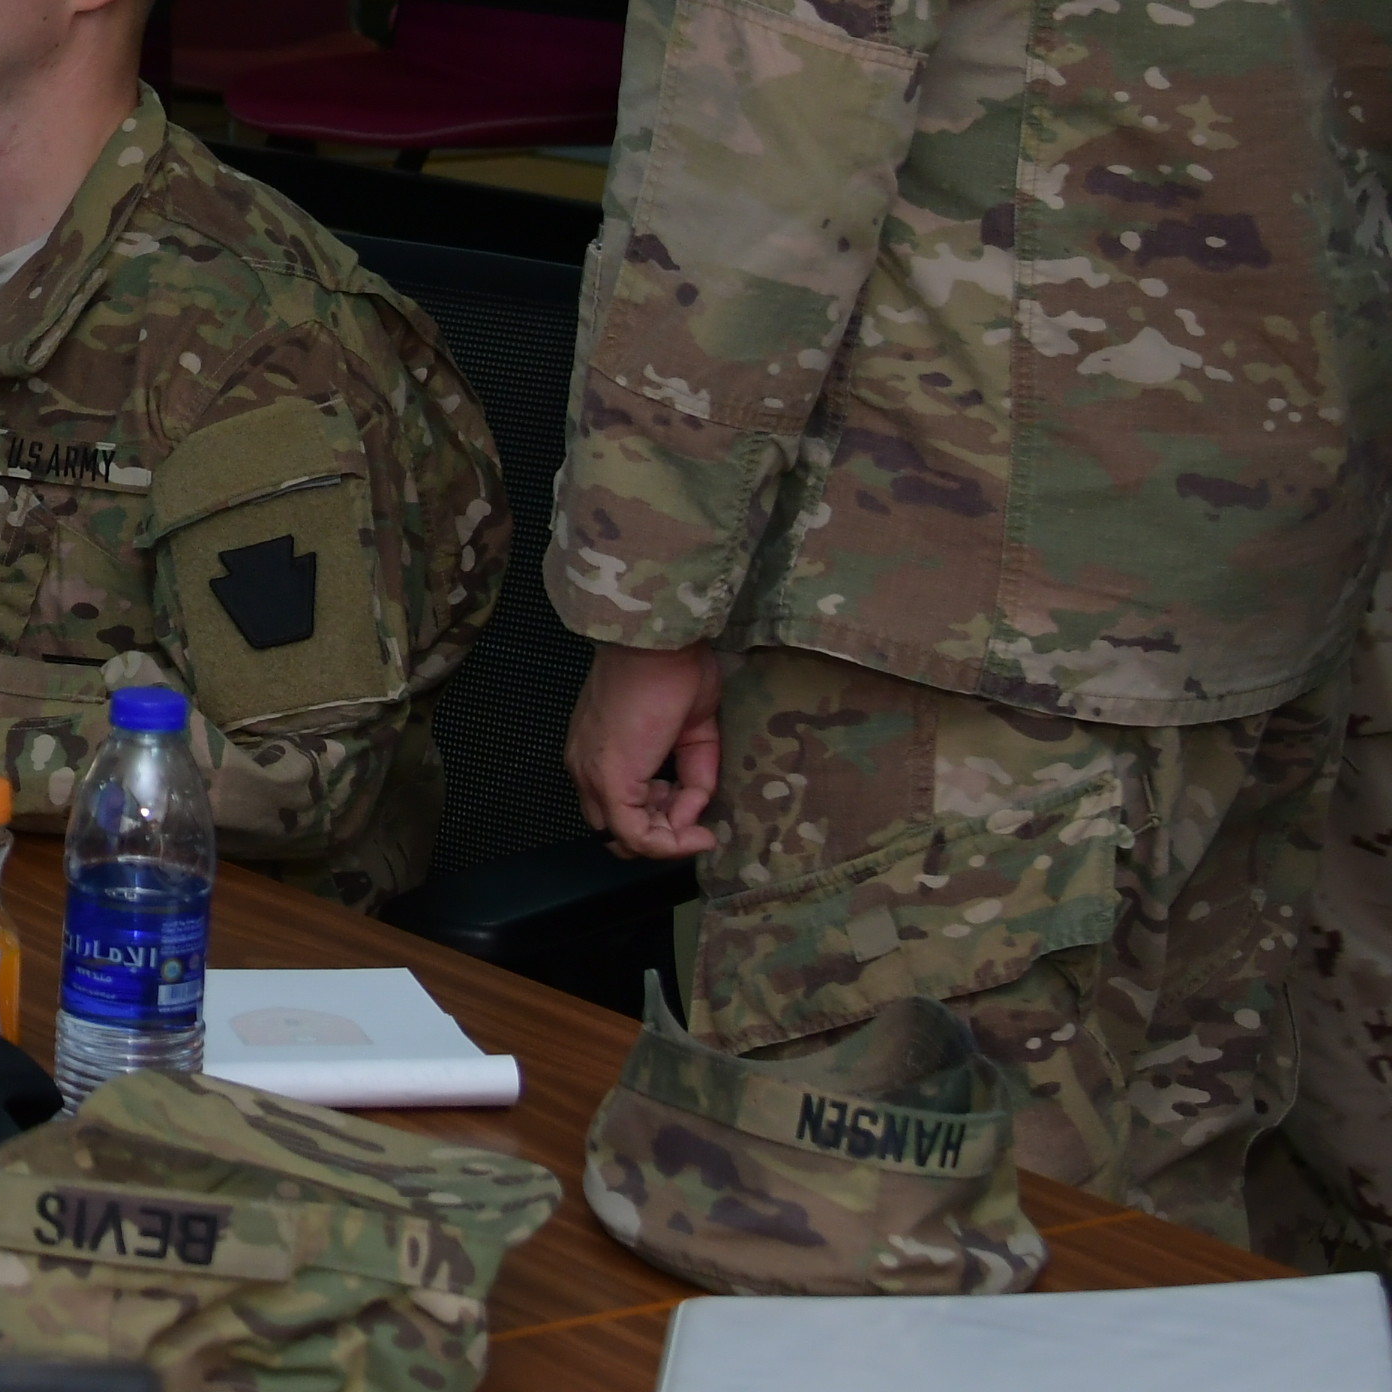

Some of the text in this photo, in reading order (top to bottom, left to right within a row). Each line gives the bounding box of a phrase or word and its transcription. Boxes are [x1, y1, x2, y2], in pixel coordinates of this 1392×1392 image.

[46, 444, 117, 483] ARMY
[795, 1092, 966, 1169] HANSEN
[32, 1191, 219, 1266] BEVIS
